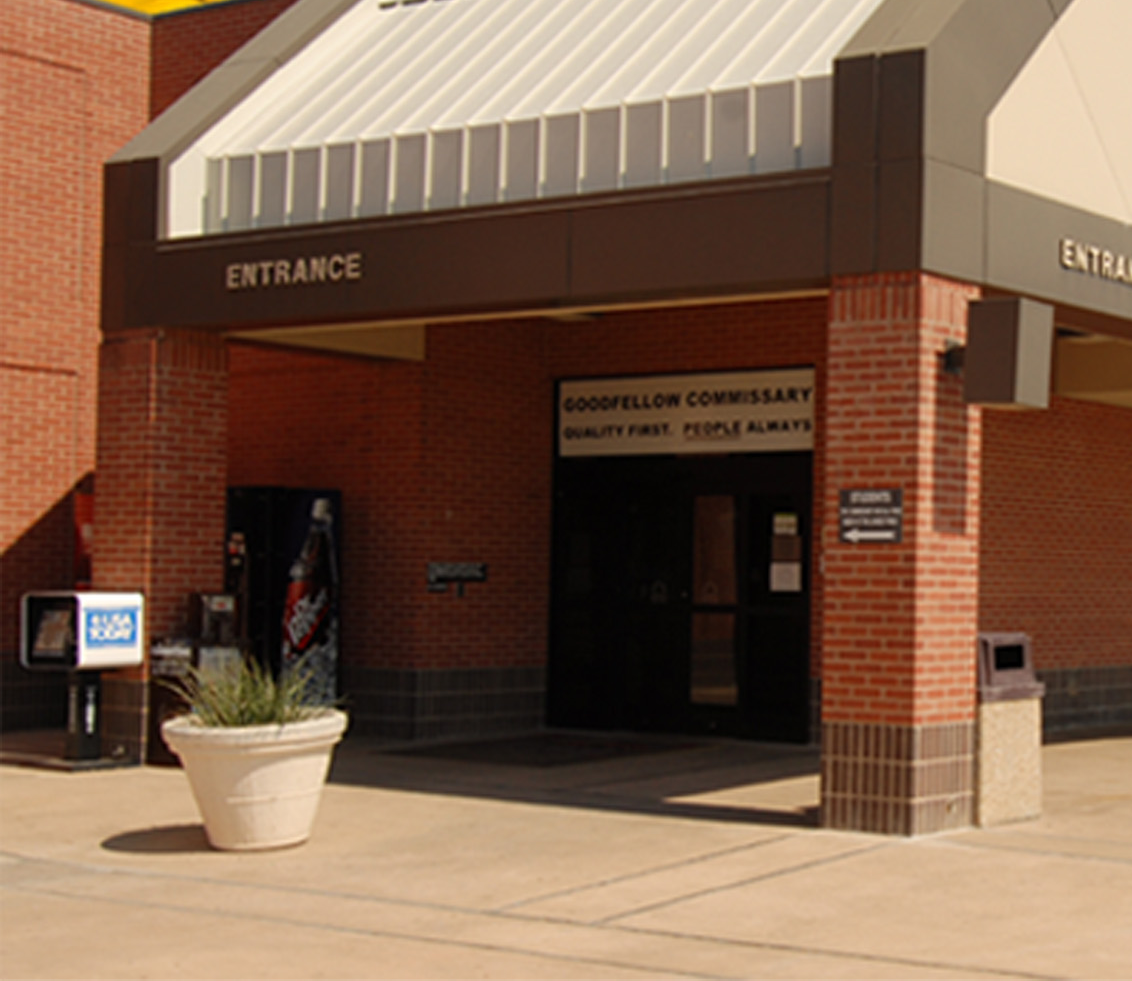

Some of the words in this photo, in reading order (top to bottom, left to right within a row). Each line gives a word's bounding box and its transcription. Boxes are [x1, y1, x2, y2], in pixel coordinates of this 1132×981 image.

[226, 252, 362, 289] ENTRANCE
[564, 394, 681, 413] GOODFELLOW
[686, 387, 812, 408] COMMISSARY
[564, 425, 624, 440] QUALITY
[683, 420, 741, 438] PEOPLE
[747, 418, 812, 434] ALWAYS
